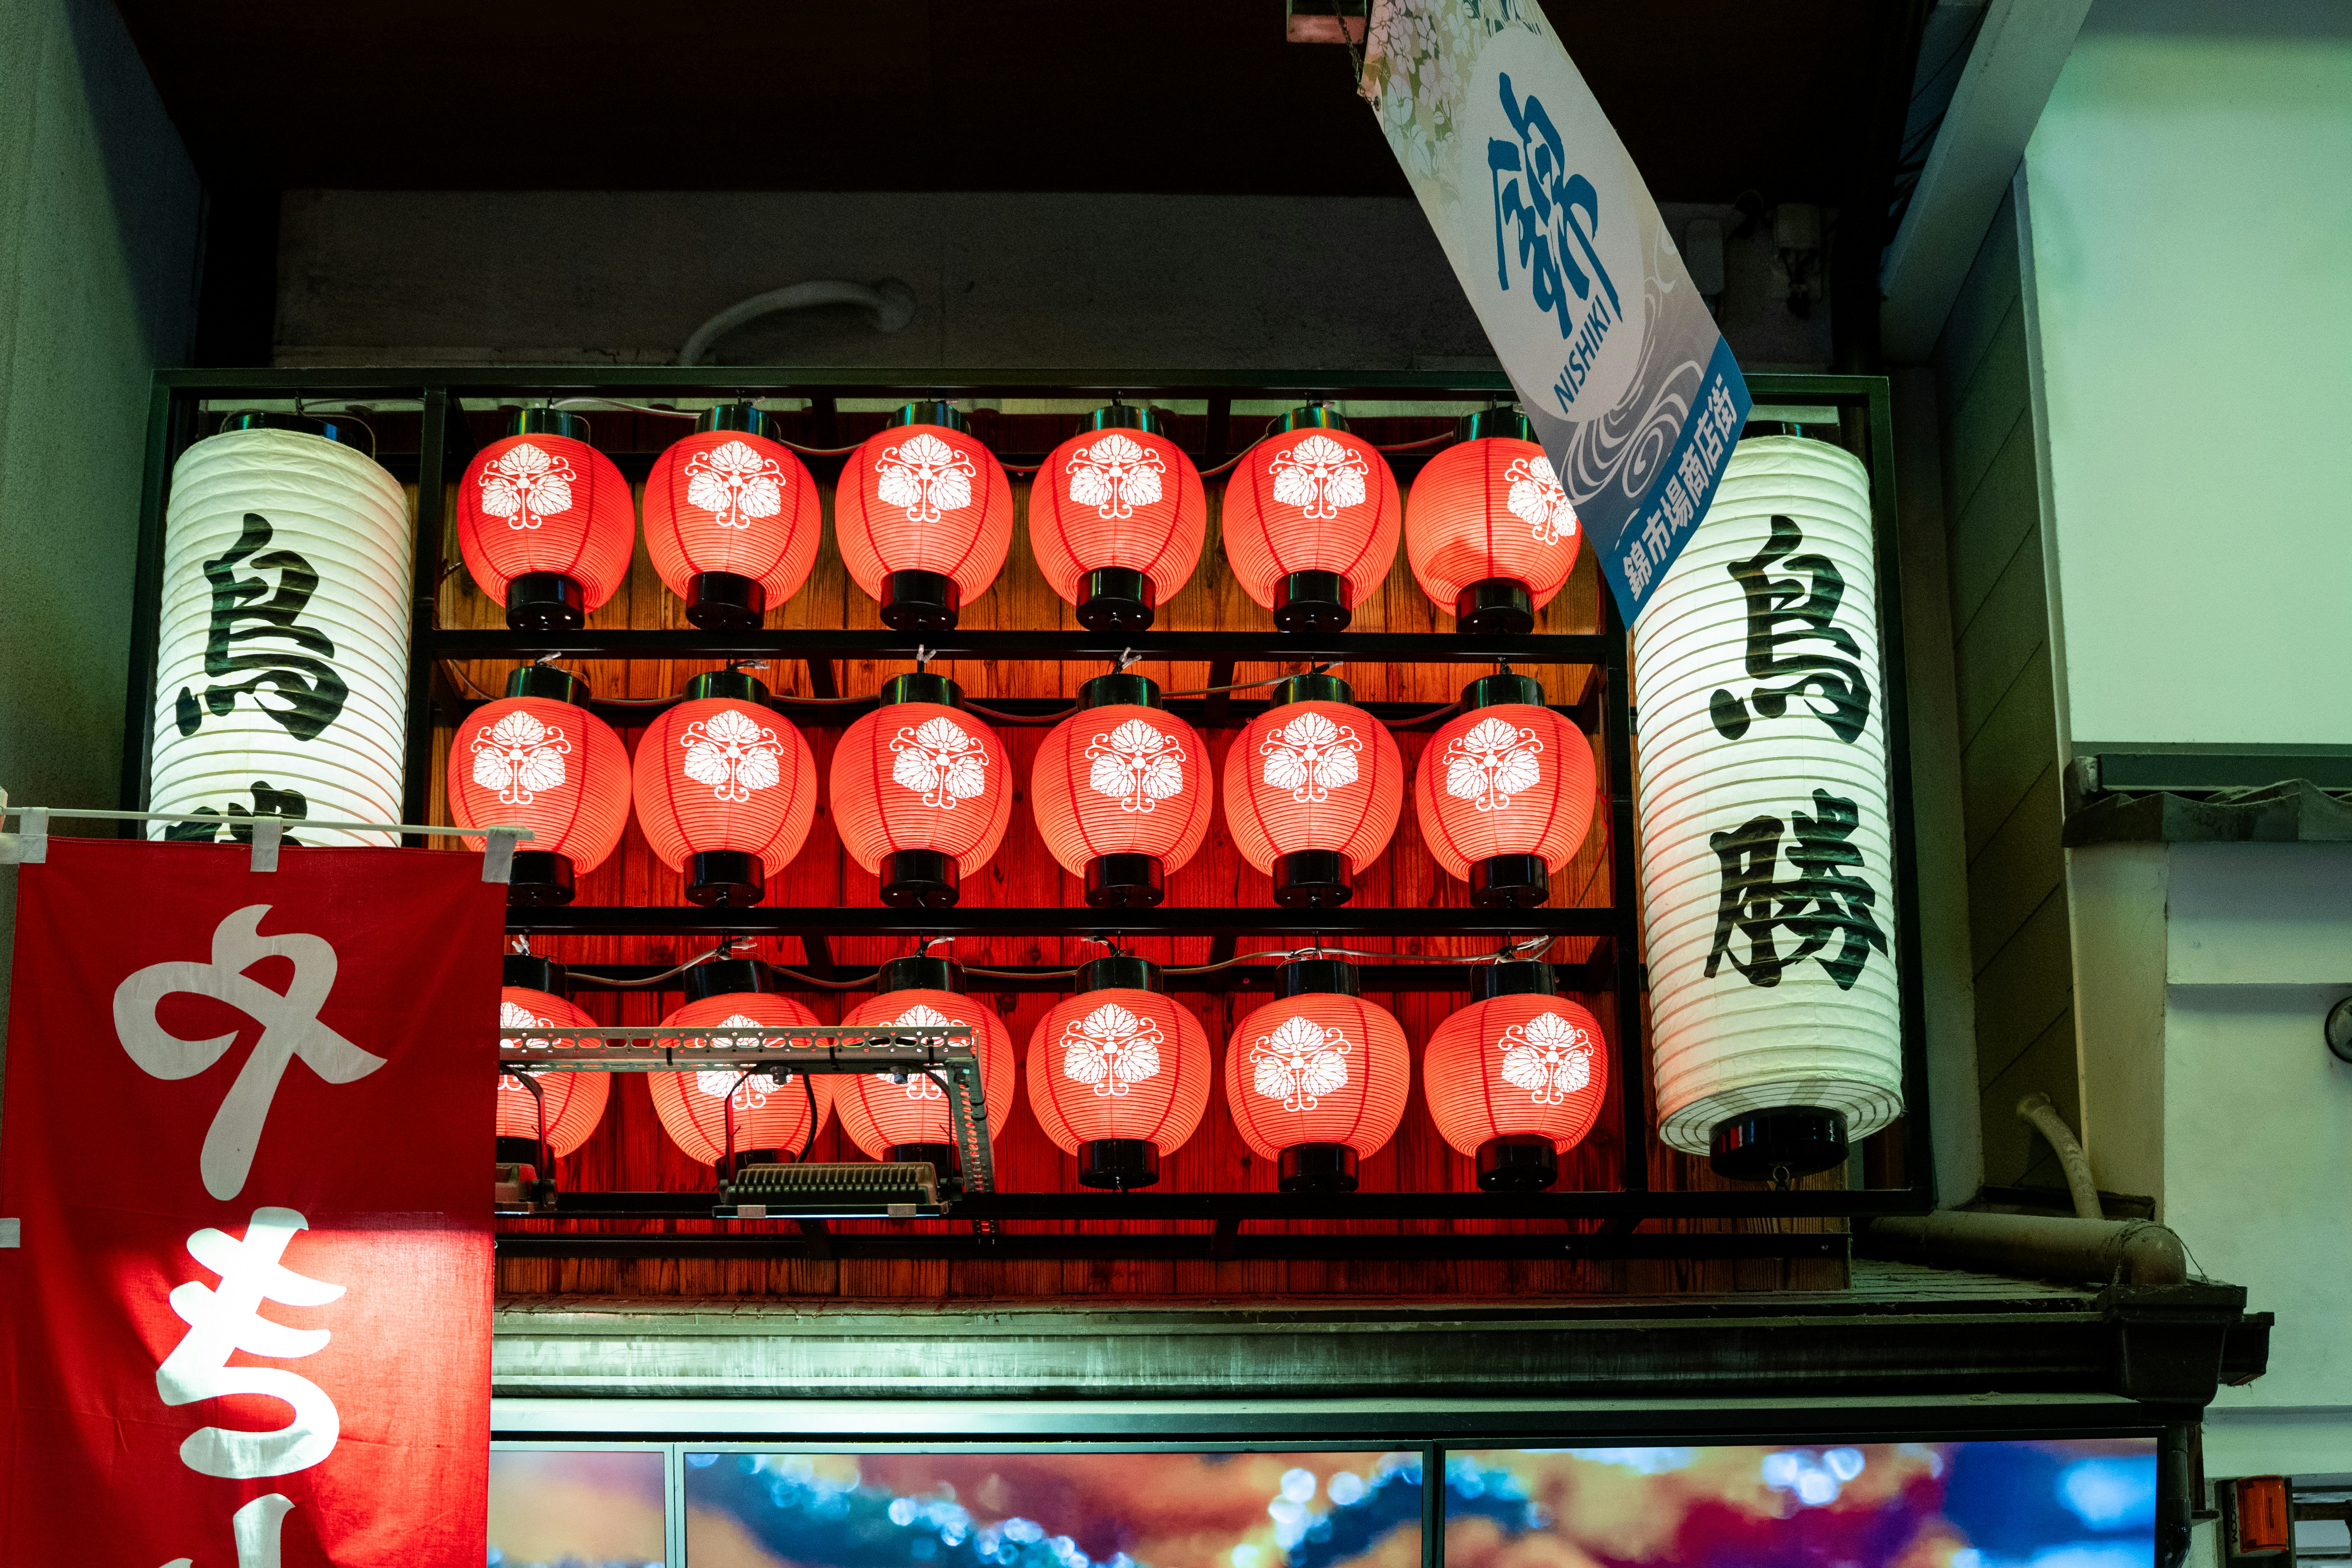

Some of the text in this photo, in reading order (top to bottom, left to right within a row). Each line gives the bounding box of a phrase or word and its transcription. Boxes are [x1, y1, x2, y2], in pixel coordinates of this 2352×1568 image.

[1553, 294, 1611, 411] NISHIKI
[1624, 373, 1737, 601] 錦市場商店街
[164, 513, 349, 846] 鳥
[1703, 515, 1888, 991] 鳥勝
[2229, 1493, 2238, 1543] SECOM
